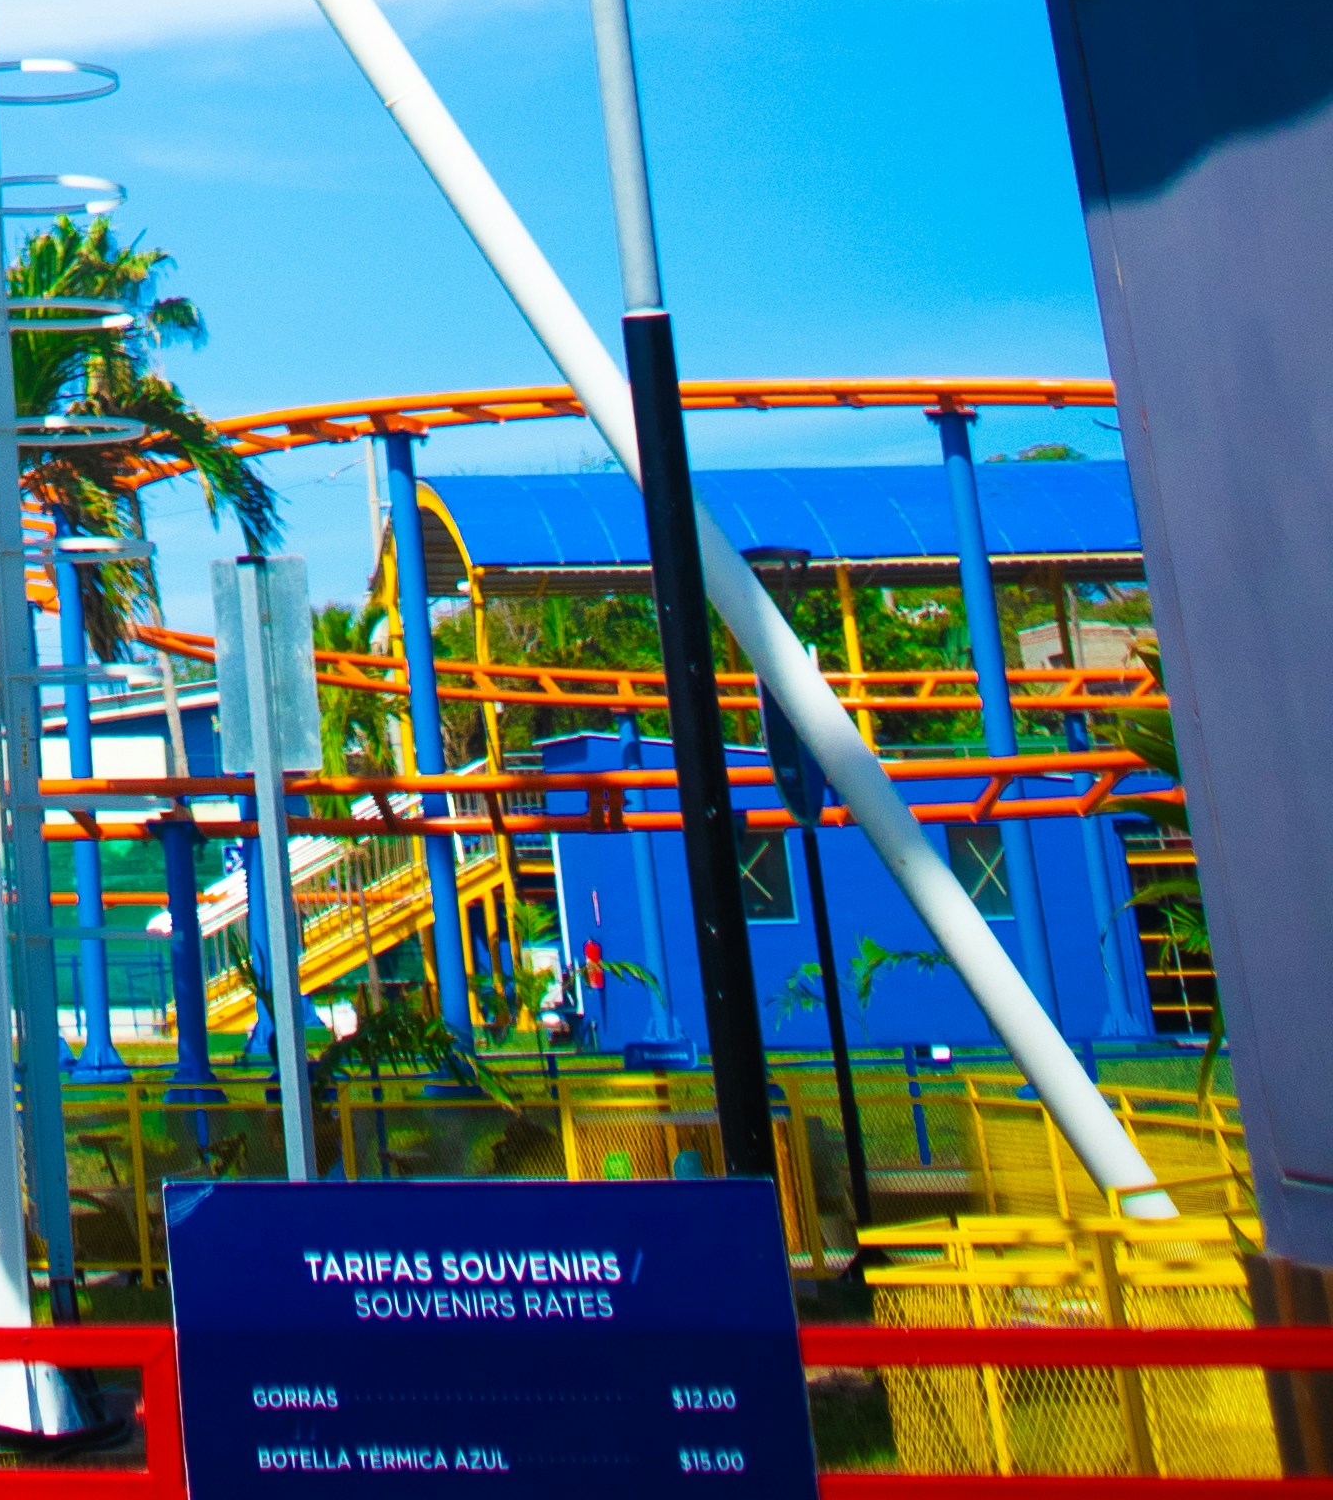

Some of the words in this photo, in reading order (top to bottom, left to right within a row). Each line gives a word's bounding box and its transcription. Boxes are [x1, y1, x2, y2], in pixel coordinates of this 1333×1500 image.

[304, 1252, 433, 1285] TARIFAS
[442, 1251, 621, 1284] SOUVENIRS
[355, 1291, 516, 1320] SOUVENIRS
[523, 1291, 614, 1320] RATES
[252, 1387, 339, 1410] GORRAS
[672, 1387, 736, 1411] $12.00
[258, 1448, 351, 1471] BOTELLA
[357, 1445, 448, 1471] TÉRMICA
[455, 1448, 509, 1472] AZUL
[679, 1449, 745, 1474] $15.00
